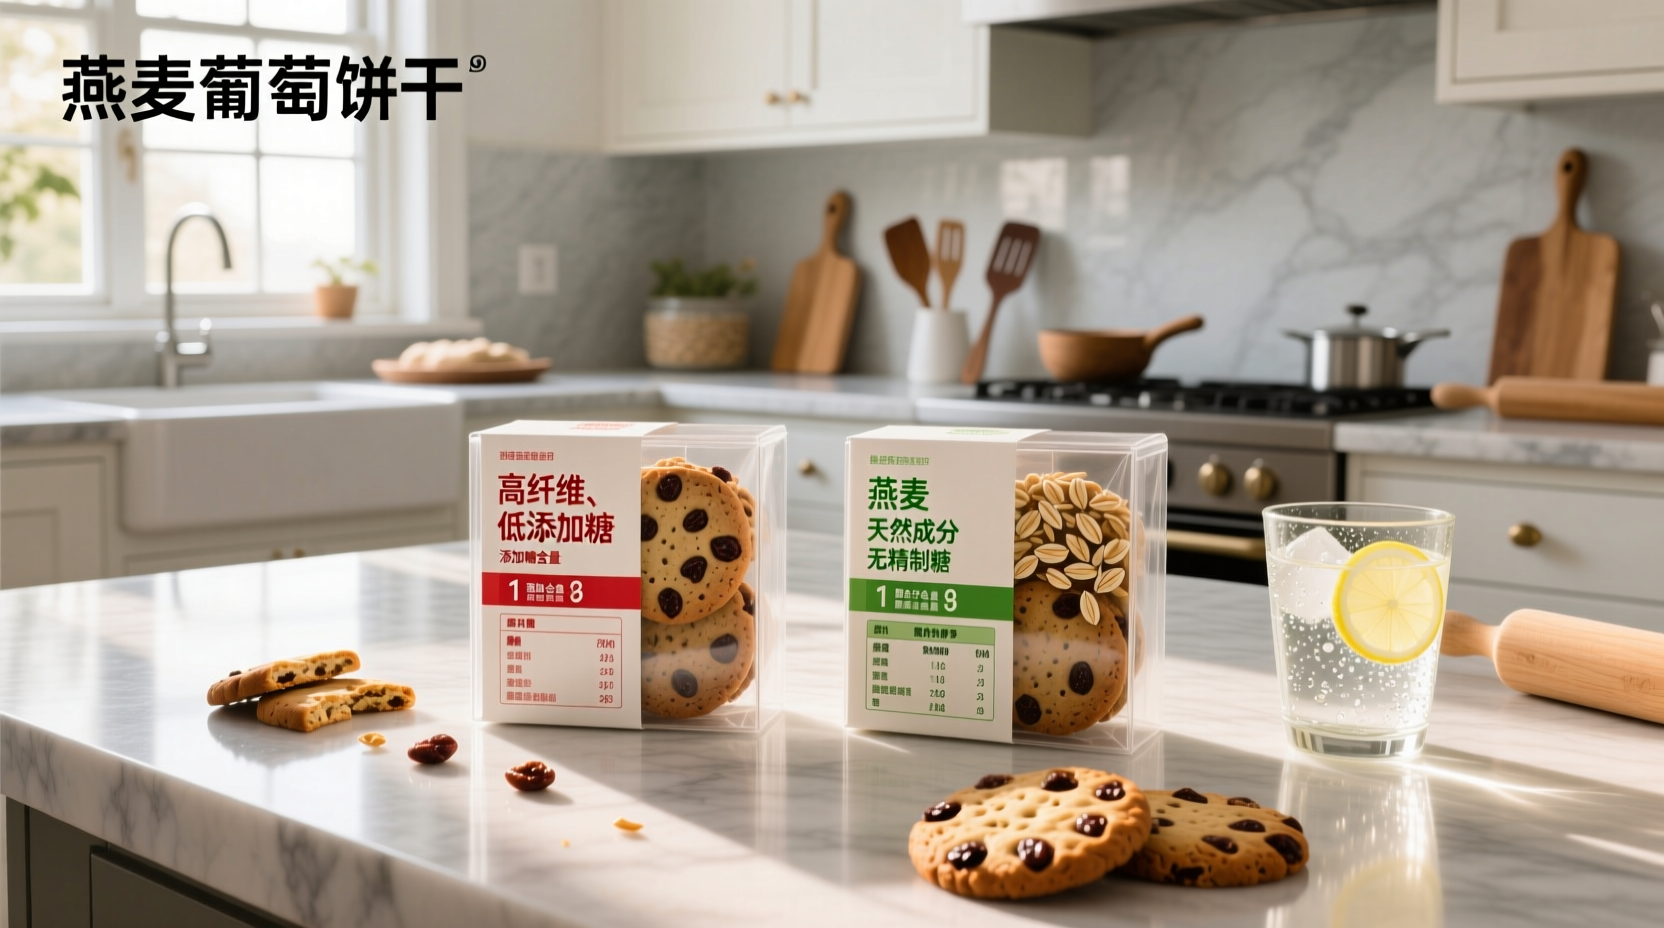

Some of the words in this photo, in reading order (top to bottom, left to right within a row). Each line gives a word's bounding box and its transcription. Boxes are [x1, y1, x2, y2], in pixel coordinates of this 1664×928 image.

[498, 473, 597, 507] 高纤维、
[868, 476, 929, 511] 燕麦
[498, 510, 615, 544] 低添加糖
[867, 517, 959, 544] 天然成分
[867, 548, 951, 573] 无精制糖
[508, 579, 519, 601] 1
[876, 585, 886, 607] 1
